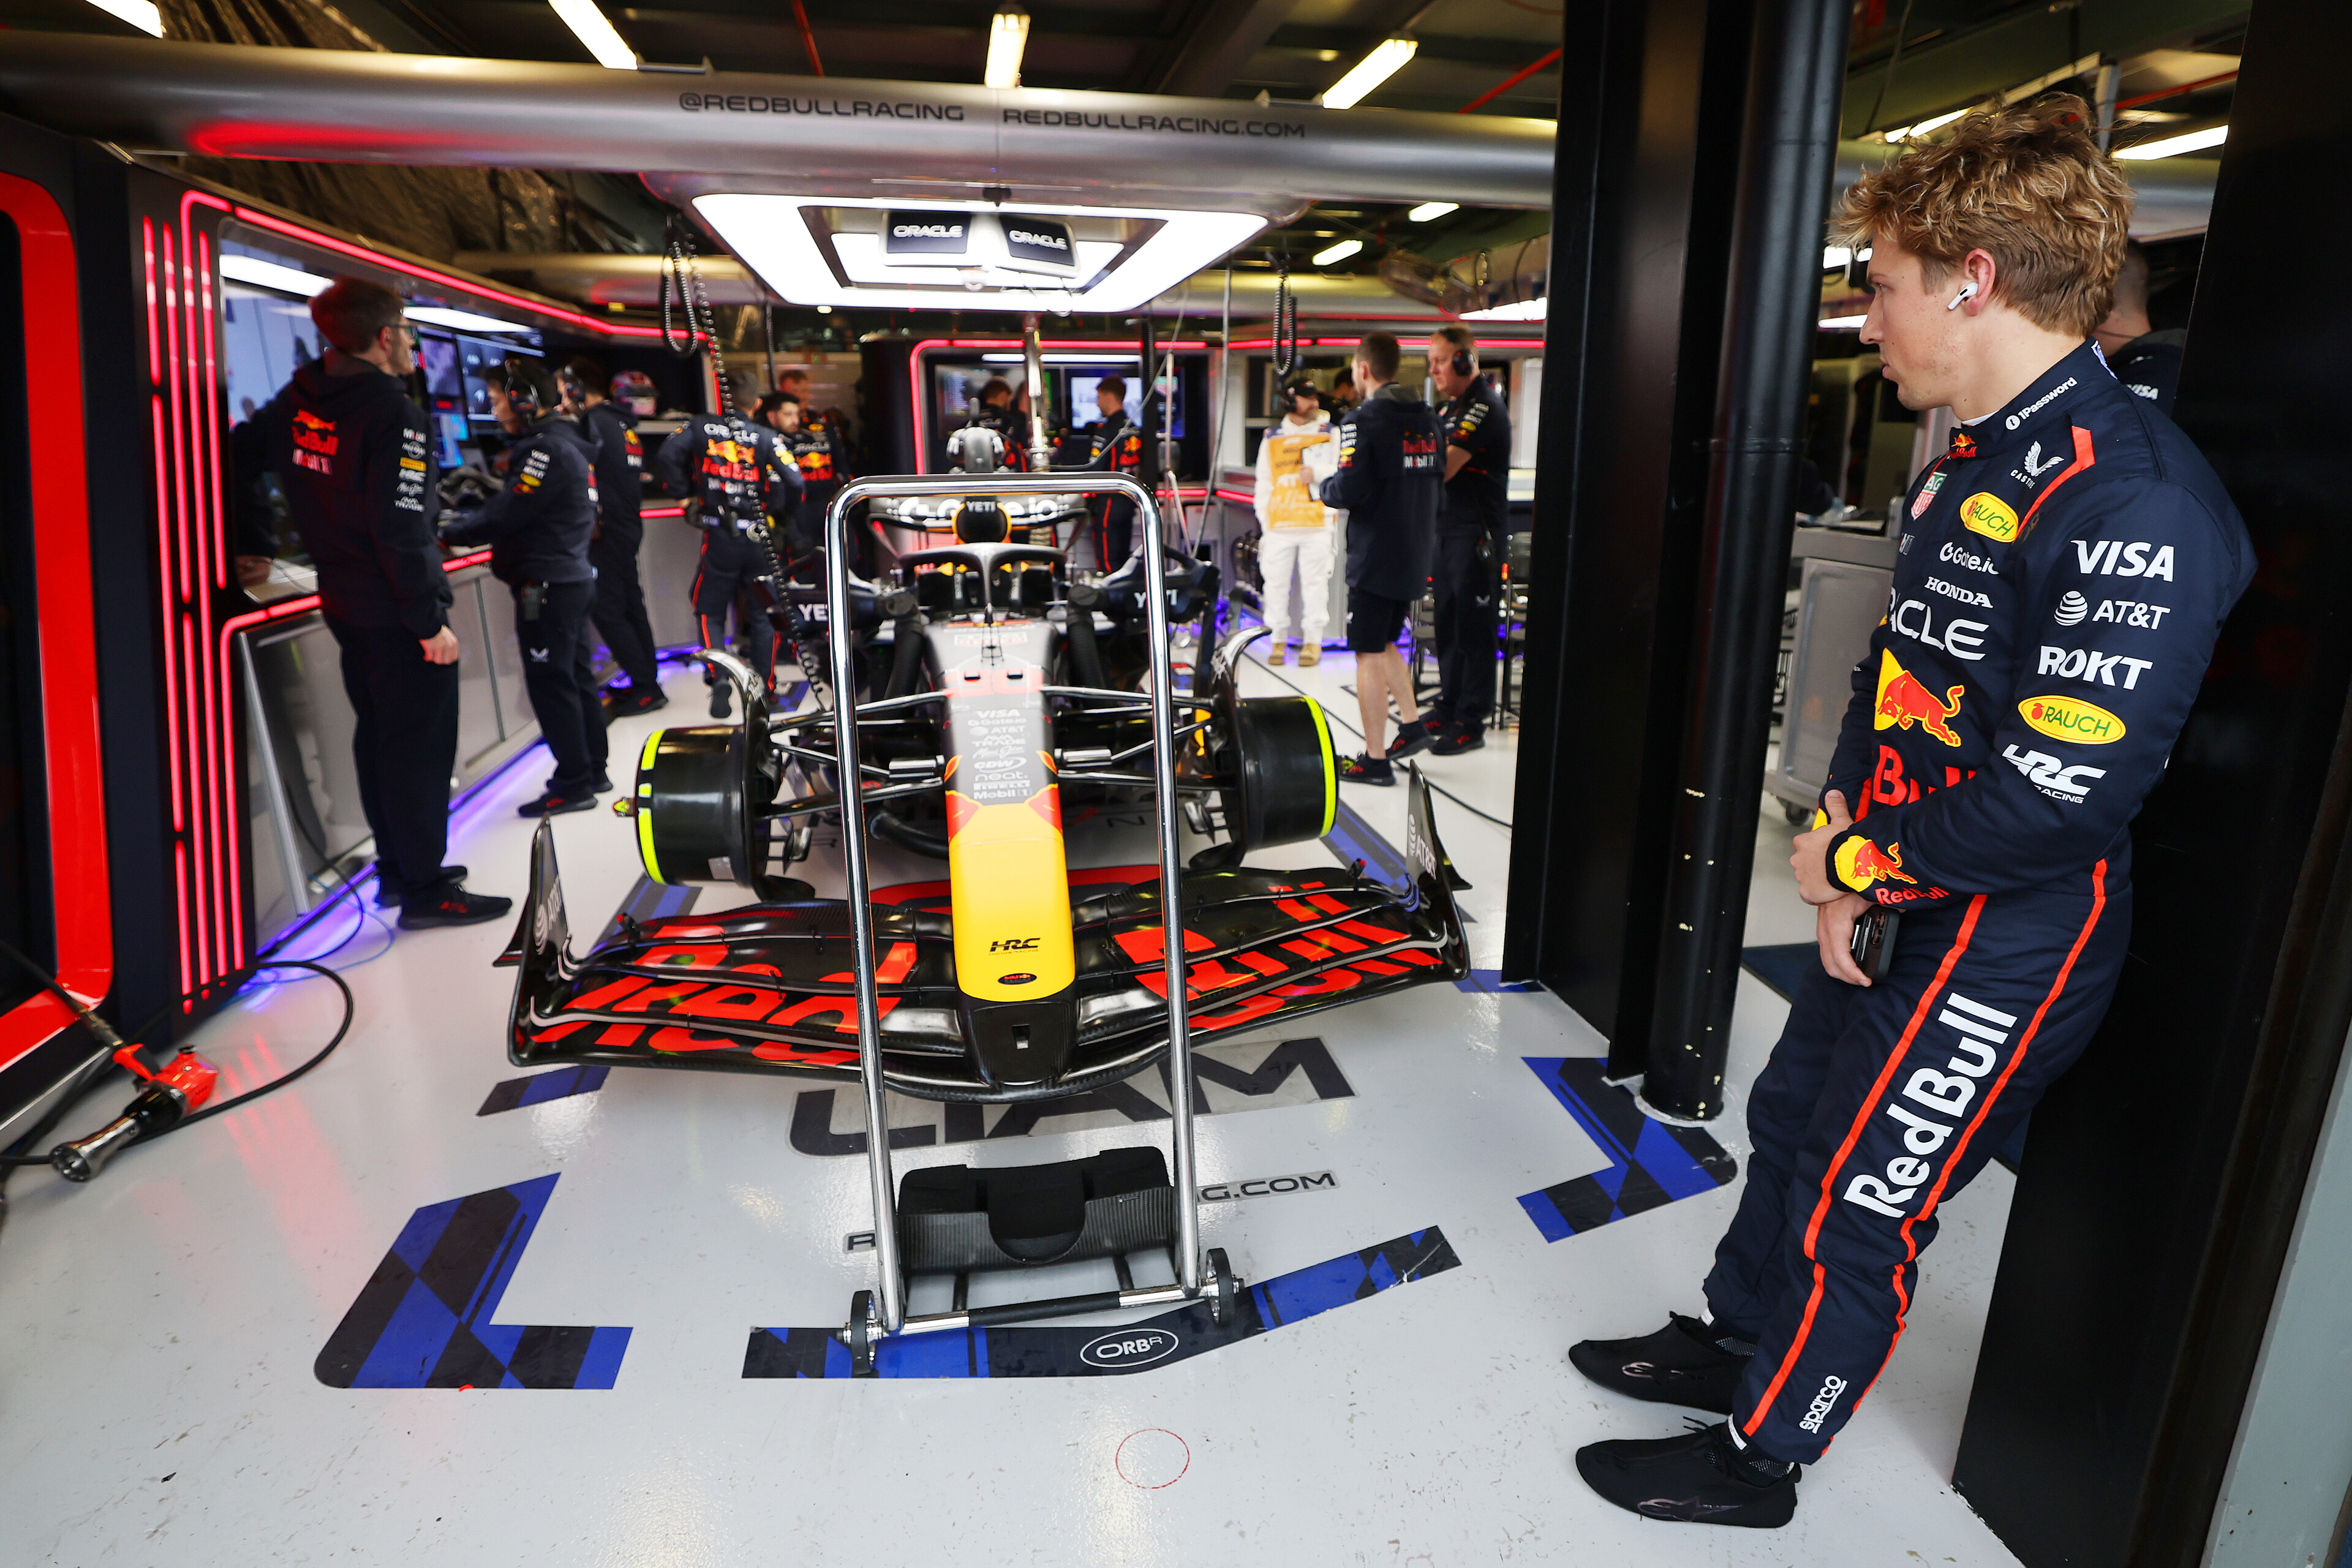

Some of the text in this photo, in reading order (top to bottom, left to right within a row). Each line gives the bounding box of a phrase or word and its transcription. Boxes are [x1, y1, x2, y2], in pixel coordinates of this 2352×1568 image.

[679, 92, 964, 121] @REDBULLRACING
[1003, 108, 1306, 138] REDBULLRACING.COM
[893, 225, 963, 238] ORACLE
[1009, 230, 1068, 251] ORACLE
[2018, 377, 2078, 420] 1Password
[1925, 475, 1944, 491] AG
[966, 500, 997, 512] YETI
[2071, 540, 2174, 582] VISA
[1924, 576, 1993, 608] HONDA
[797, 603, 828, 622] YE
[1890, 586, 1989, 661] CLE
[2092, 600, 2171, 630] AT&T
[2038, 646, 2153, 690] ROKT
[976, 709, 1020, 718] VISA
[2043, 706, 2111, 736] RAUCH
[991, 725, 1026, 734] AT&T
[975, 771, 1028, 782] neat.
[974, 788, 1016, 799] Mobil
[990, 938, 1041, 952] HRC
[1799, 1375, 1848, 1434] sparco
